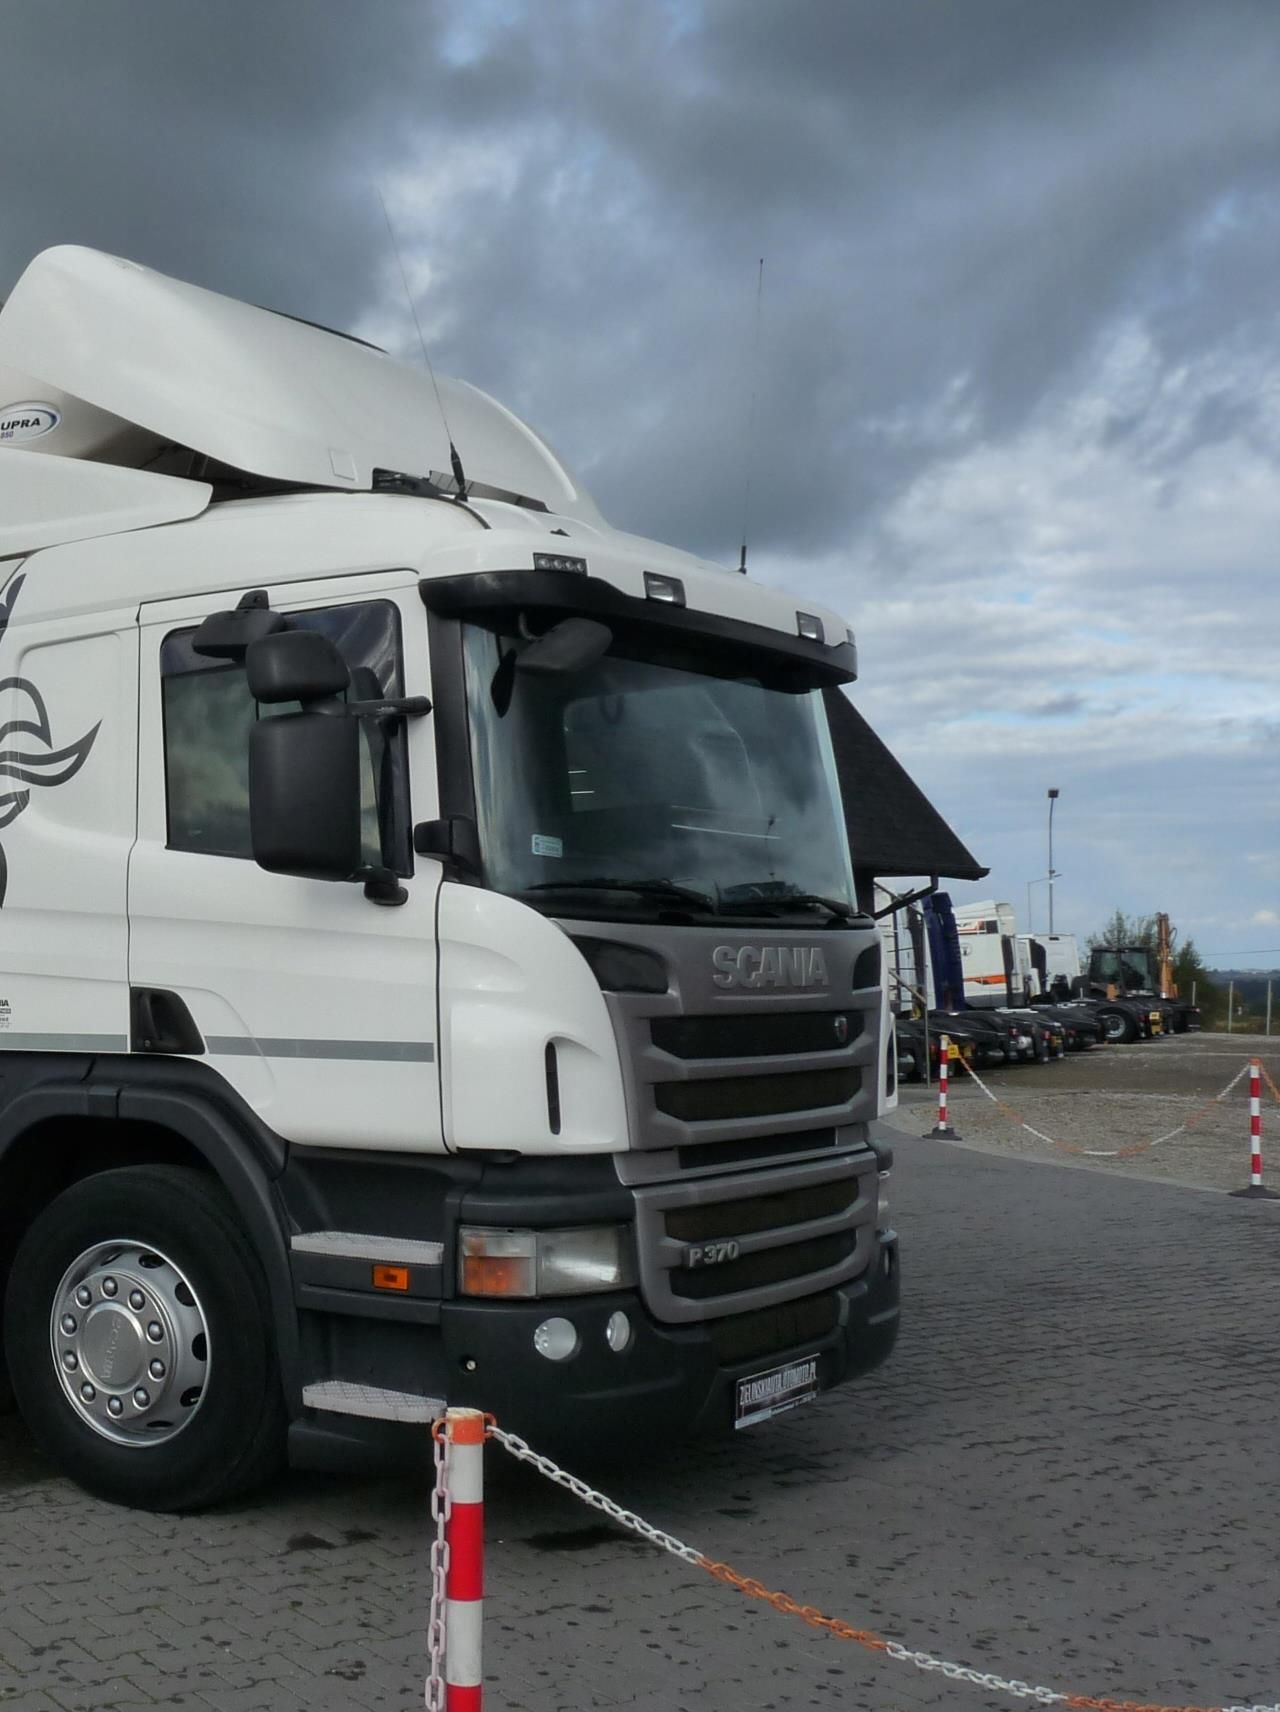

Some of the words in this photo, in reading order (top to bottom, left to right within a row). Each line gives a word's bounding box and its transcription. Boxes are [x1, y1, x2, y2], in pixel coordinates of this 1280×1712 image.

[712, 945, 830, 988] SCANIA
[688, 1247, 704, 1268] P
[704, 1241, 740, 1265] 370
